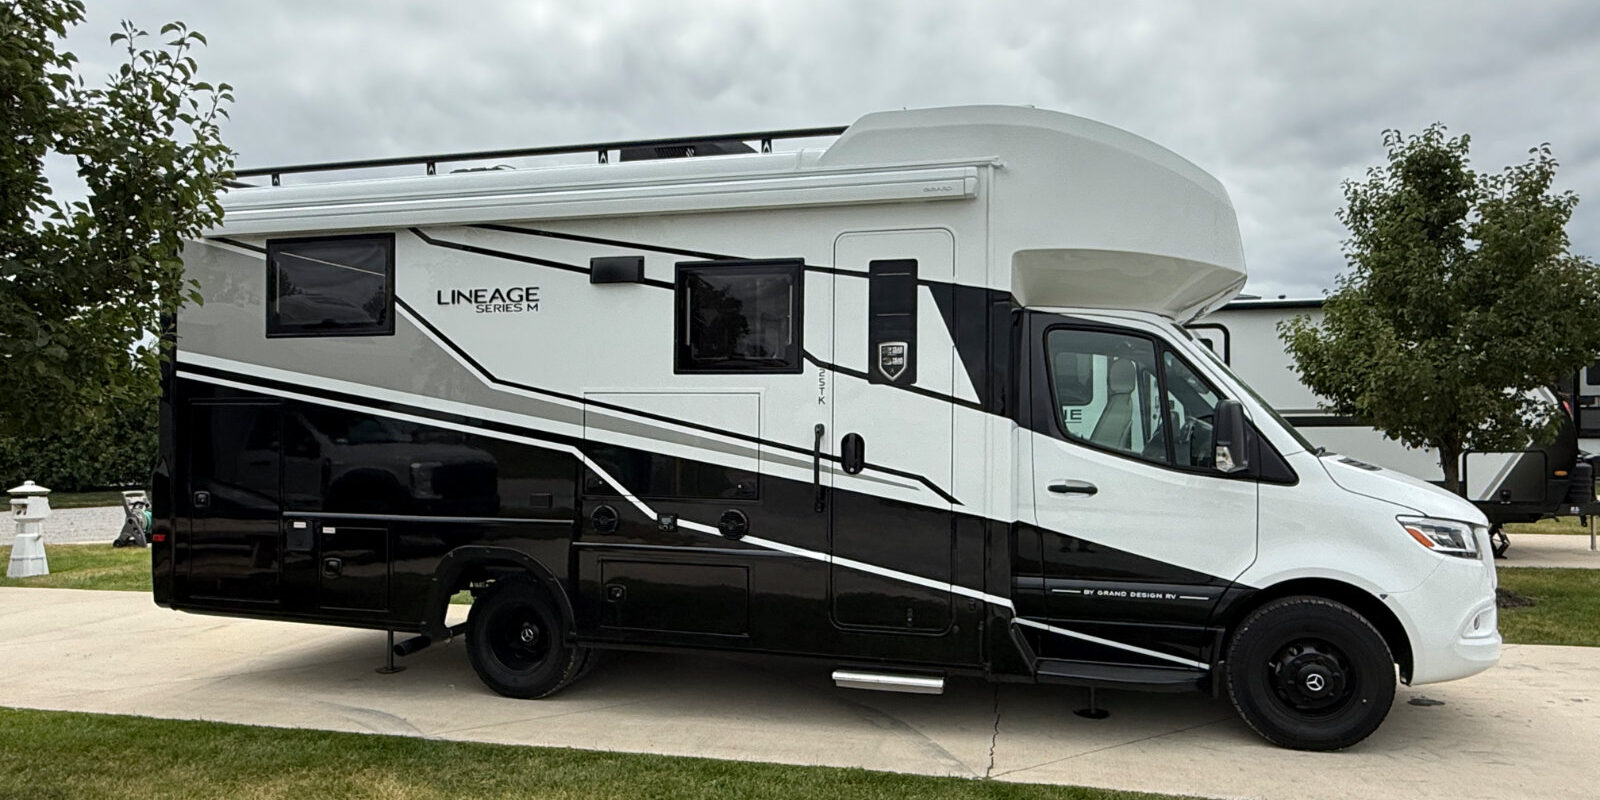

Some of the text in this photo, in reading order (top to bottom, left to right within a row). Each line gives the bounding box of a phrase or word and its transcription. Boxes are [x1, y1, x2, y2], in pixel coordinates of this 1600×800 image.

[437, 287, 540, 305] LINEAGE
[475, 303, 539, 314] SERIES M
[1130, 591, 1163, 599] DESIGN
